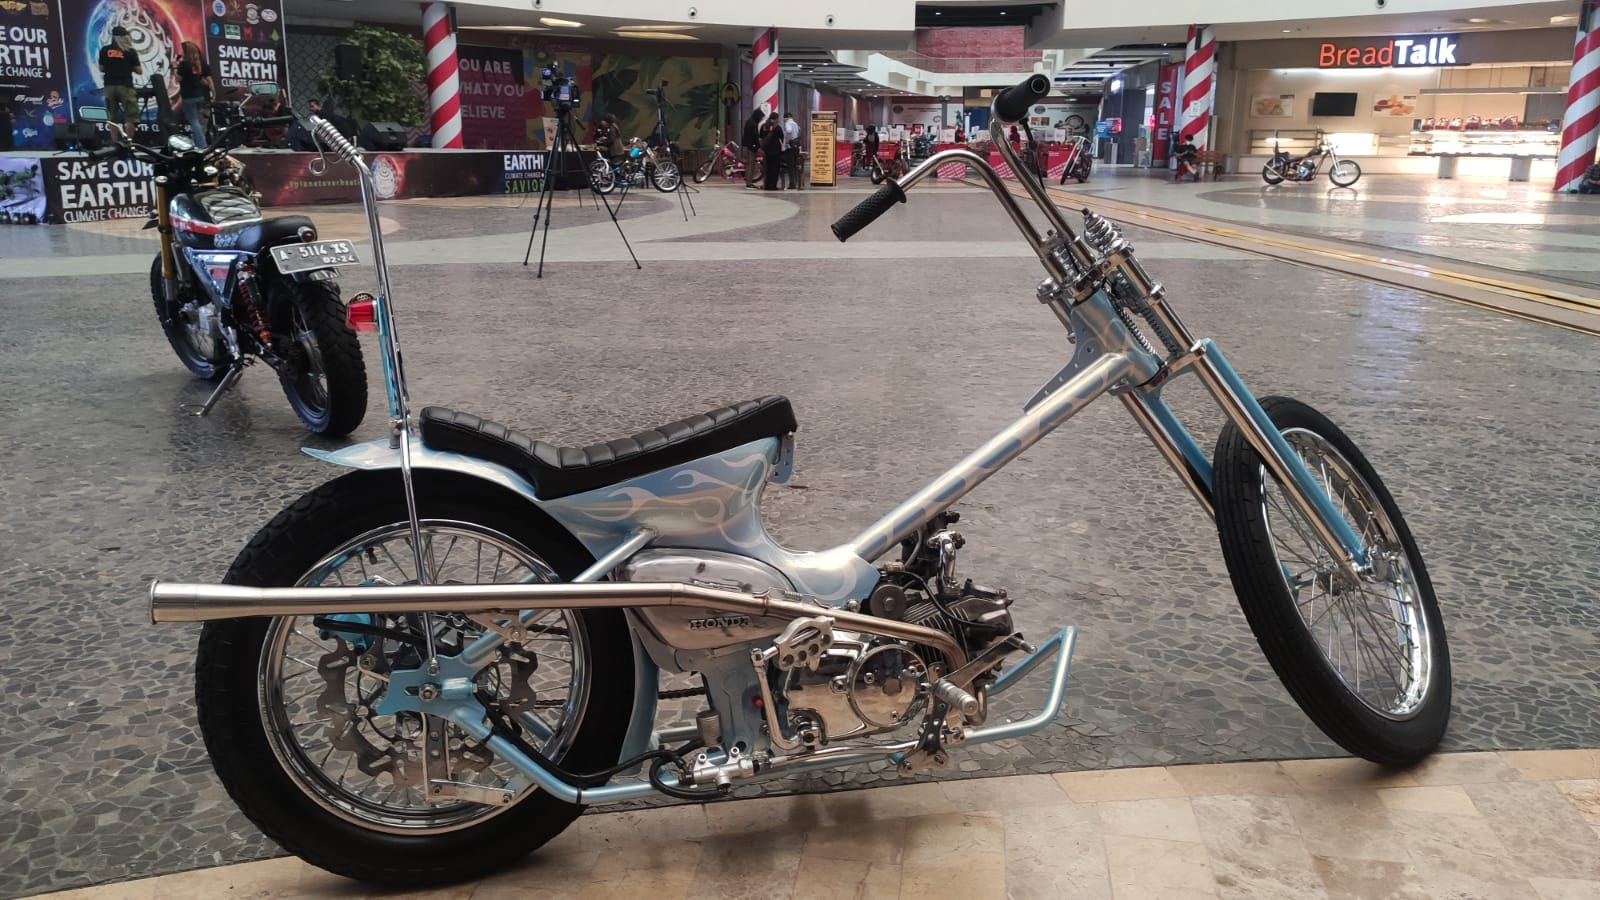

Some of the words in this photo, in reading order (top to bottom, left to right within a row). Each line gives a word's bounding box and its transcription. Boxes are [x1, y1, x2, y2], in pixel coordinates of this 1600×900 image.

[9, 26, 48, 44] OUR
[0, 44, 52, 79] RTH!
[218, 44, 250, 60] SAVE
[250, 47, 277, 61] OUR
[1319, 37, 1457, 67] BreadTalk
[5, 65, 44, 79] CHANGE
[219, 60, 278, 83] EARTH!
[460, 58, 480, 71] OU
[484, 60, 511, 74] ARE
[494, 84, 525, 97] YOU
[461, 105, 505, 118] ELIEVE
[1158, 82, 1171, 140] SALE
[57, 160, 110, 181] SAVE
[113, 157, 154, 178] OUR
[503, 154, 544, 177] EARTH!
[60, 180, 157, 209] EARTH!
[63, 209, 106, 224] CLIMATE
[107, 205, 148, 220] CHANGE
